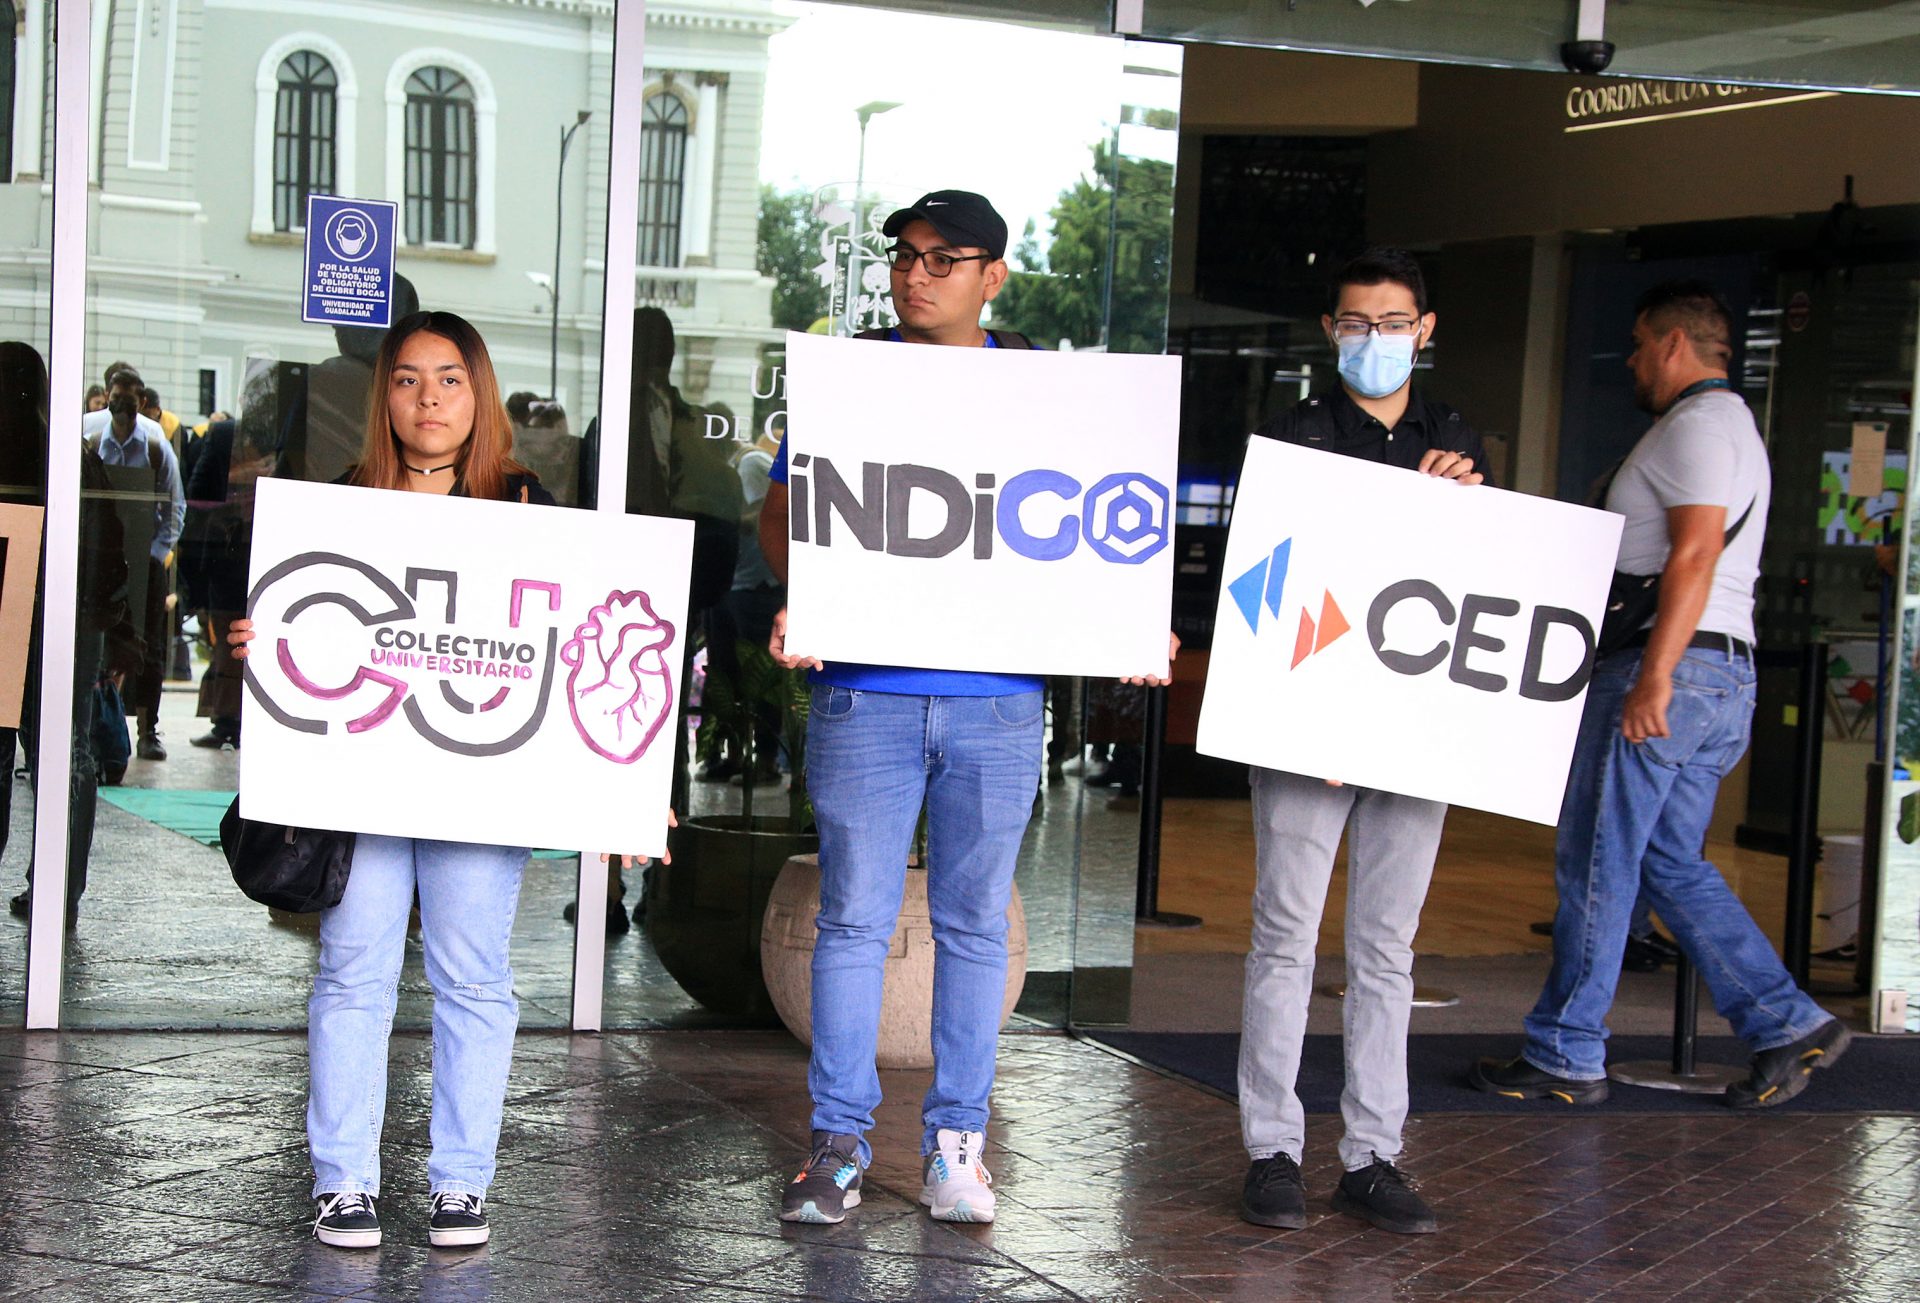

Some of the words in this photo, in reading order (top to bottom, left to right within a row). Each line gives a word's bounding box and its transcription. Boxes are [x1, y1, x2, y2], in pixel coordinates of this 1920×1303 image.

[320, 263, 337, 271] POR
[352, 266, 380, 275] SALUD
[317, 270, 329, 278] DE
[331, 271, 361, 282] TODOS,
[363, 274, 381, 283] USO
[312, 284, 324, 292] DE
[325, 286, 354, 295] CUBRE
[356, 288, 385, 297] BOCAS
[320, 278, 377, 290] OBLIGATORIO
[321, 299, 364, 310] UNIVERSIDAD
[365, 303, 375, 311] DE
[324, 307, 371, 317] GUADALAJARA
[703, 413, 753, 442] DE
[375, 627, 536, 664] COLECTIVO
[1366, 578, 1598, 702] CED
[370, 648, 534, 681] UNIVERSITARIO
